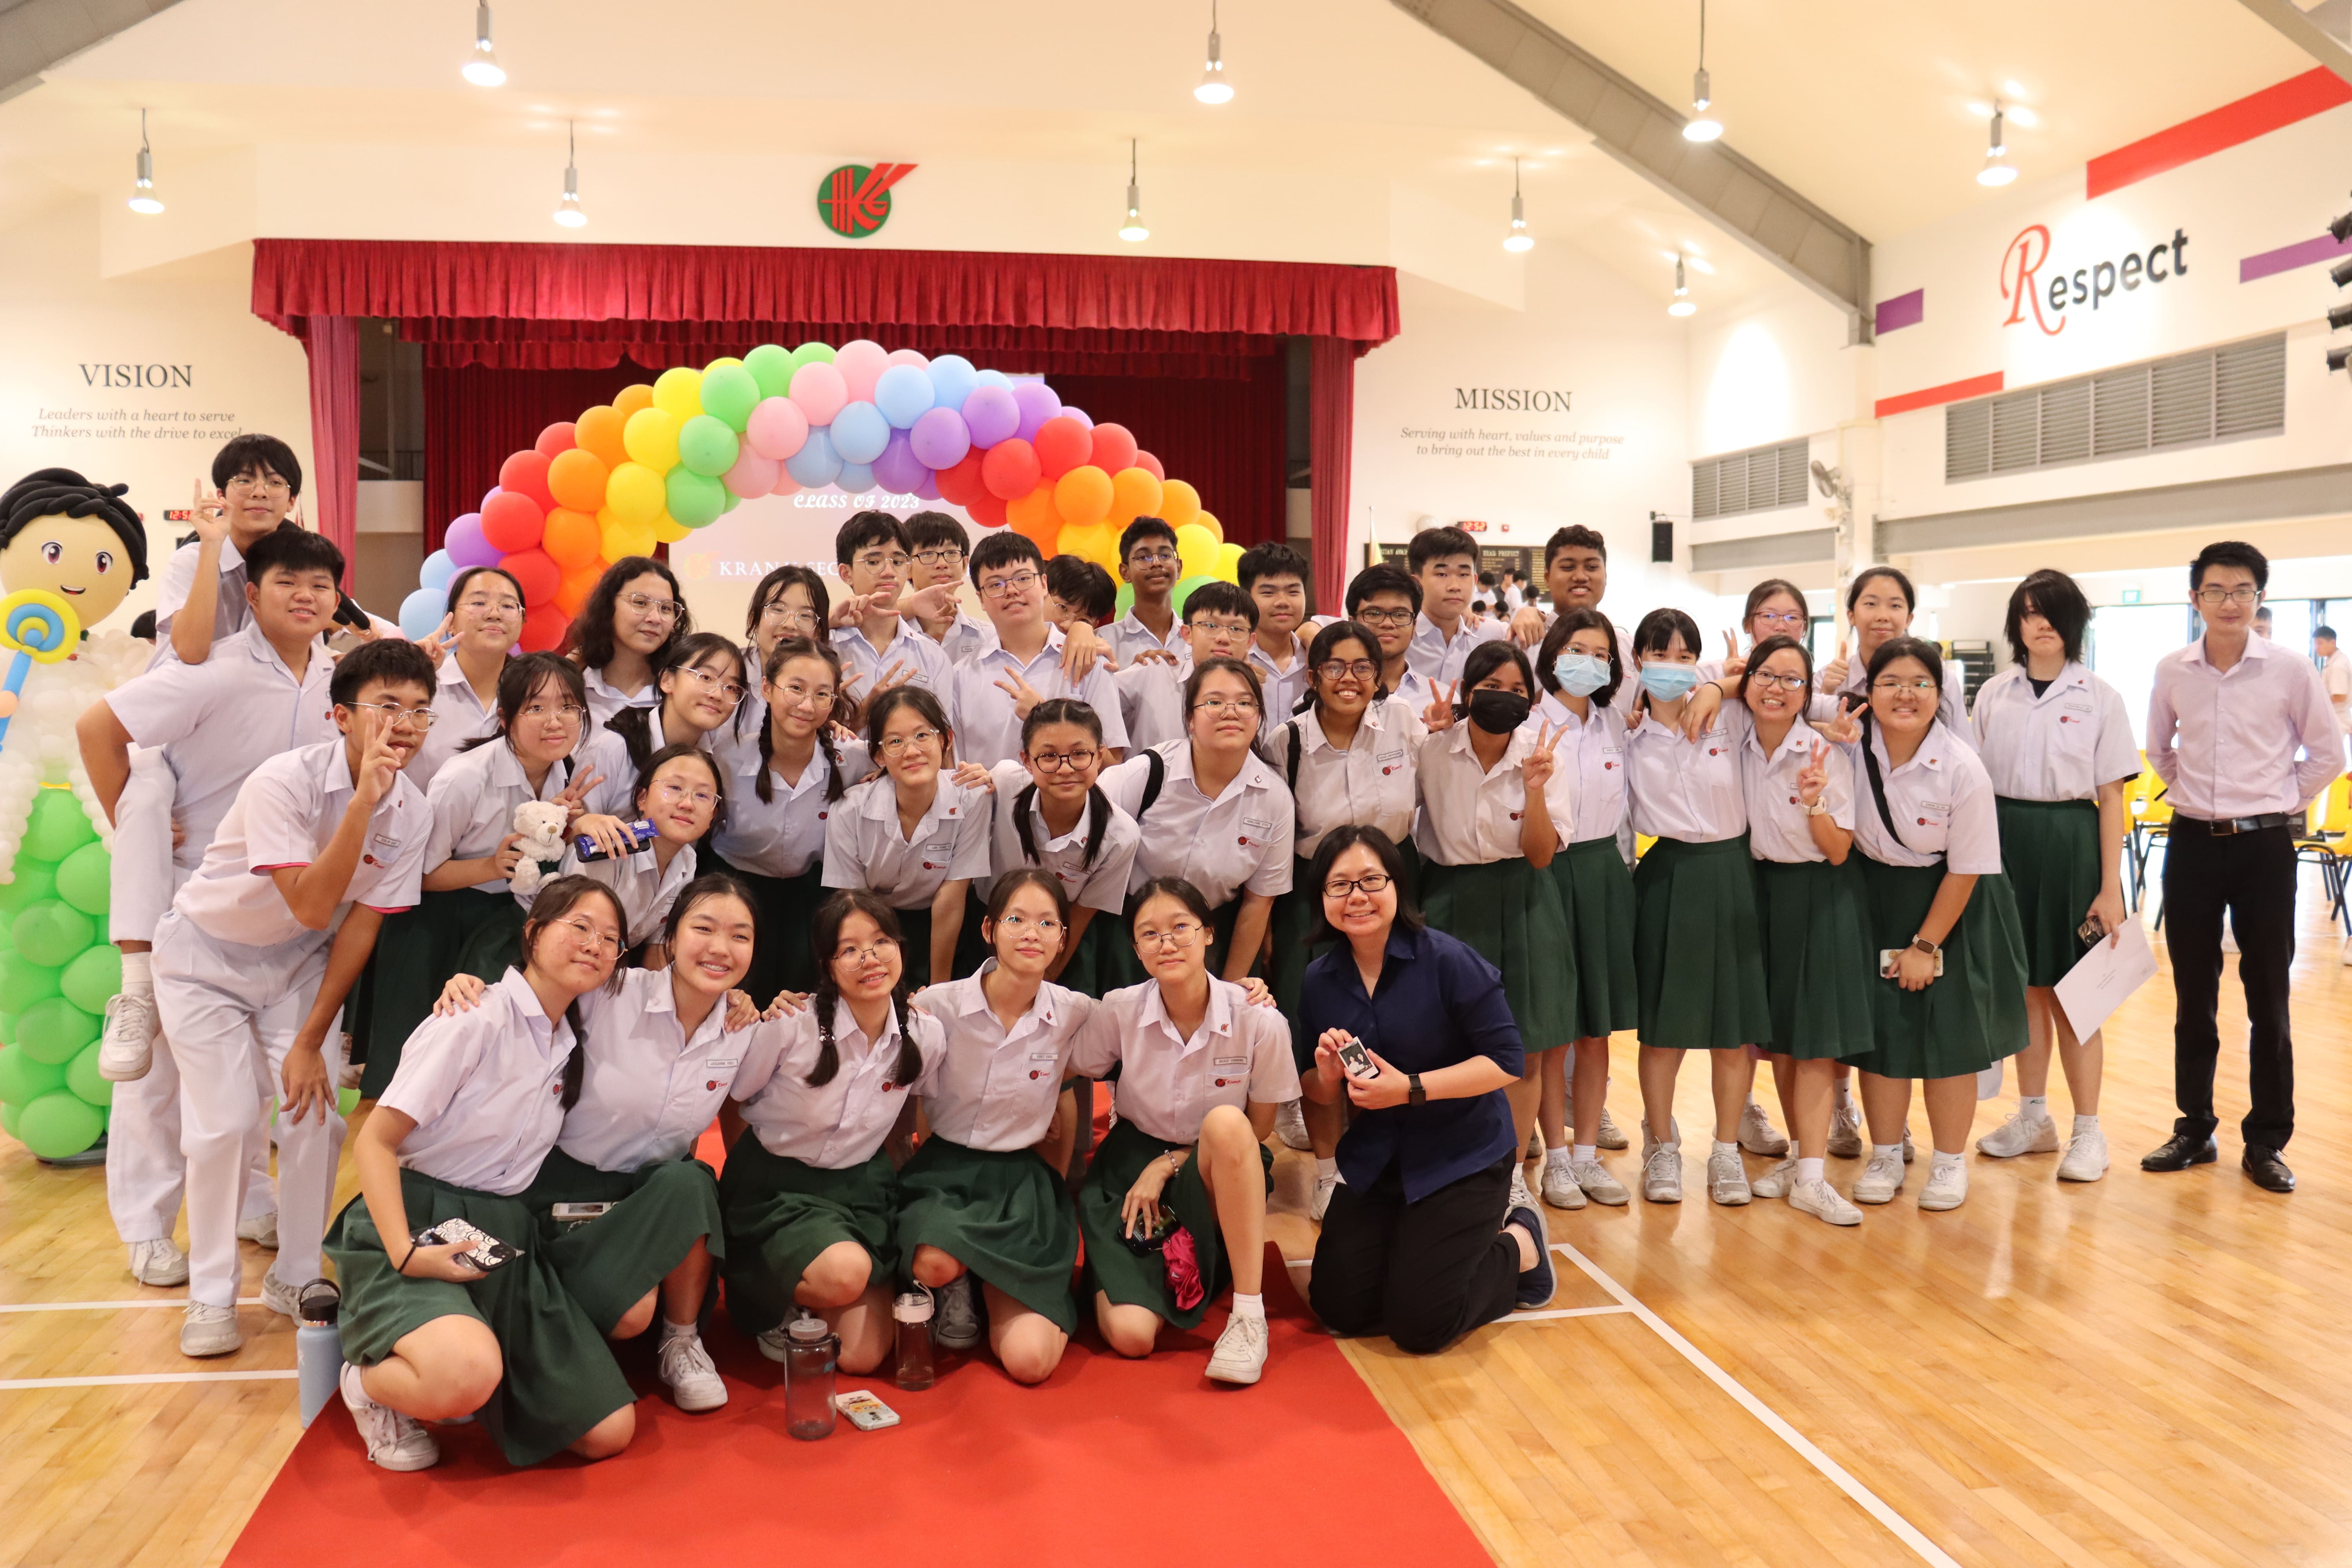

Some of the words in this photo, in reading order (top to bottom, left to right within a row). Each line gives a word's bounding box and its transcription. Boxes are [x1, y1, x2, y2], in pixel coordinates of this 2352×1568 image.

[2001, 224, 2189, 336] Respect
[78, 364, 192, 388] VISION
[1455, 388, 1573, 412] MISSION
[39, 408, 93, 420] Leaders
[97, 408, 127, 421] with
[131, 412, 139, 421] a
[143, 409, 179, 421] heart
[183, 412, 196, 421] to
[199, 413, 235, 421] serve
[32, 425, 91, 437] Thinkers
[96, 426, 126, 438] with
[130, 427, 150, 439] the
[154, 427, 189, 439] drive
[193, 429, 206, 439] to
[209, 427, 242, 439] excel
[1401, 427, 1446, 441] Serving
[1449, 428, 1475, 440] with
[1478, 429, 1513, 442] heart,
[1515, 430, 1552, 442] values
[1554, 432, 1576, 443] and
[1578, 434, 1624, 445] purpose
[1417, 445, 1428, 455] to
[1431, 444, 1463, 458] bring
[1466, 446, 1485, 456] out
[1488, 445, 1506, 456] the
[1508, 446, 1531, 457] best
[1534, 448, 1545, 457] in
[1548, 450, 1579, 461] every
[1582, 448, 1609, 459] child
[793, 494, 848, 508] CLASS
[853, 495, 876, 508] OF
[880, 495, 920, 508] 2023
[169, 510, 193, 520] 12:5
[719, 561, 798, 575] KRAN
